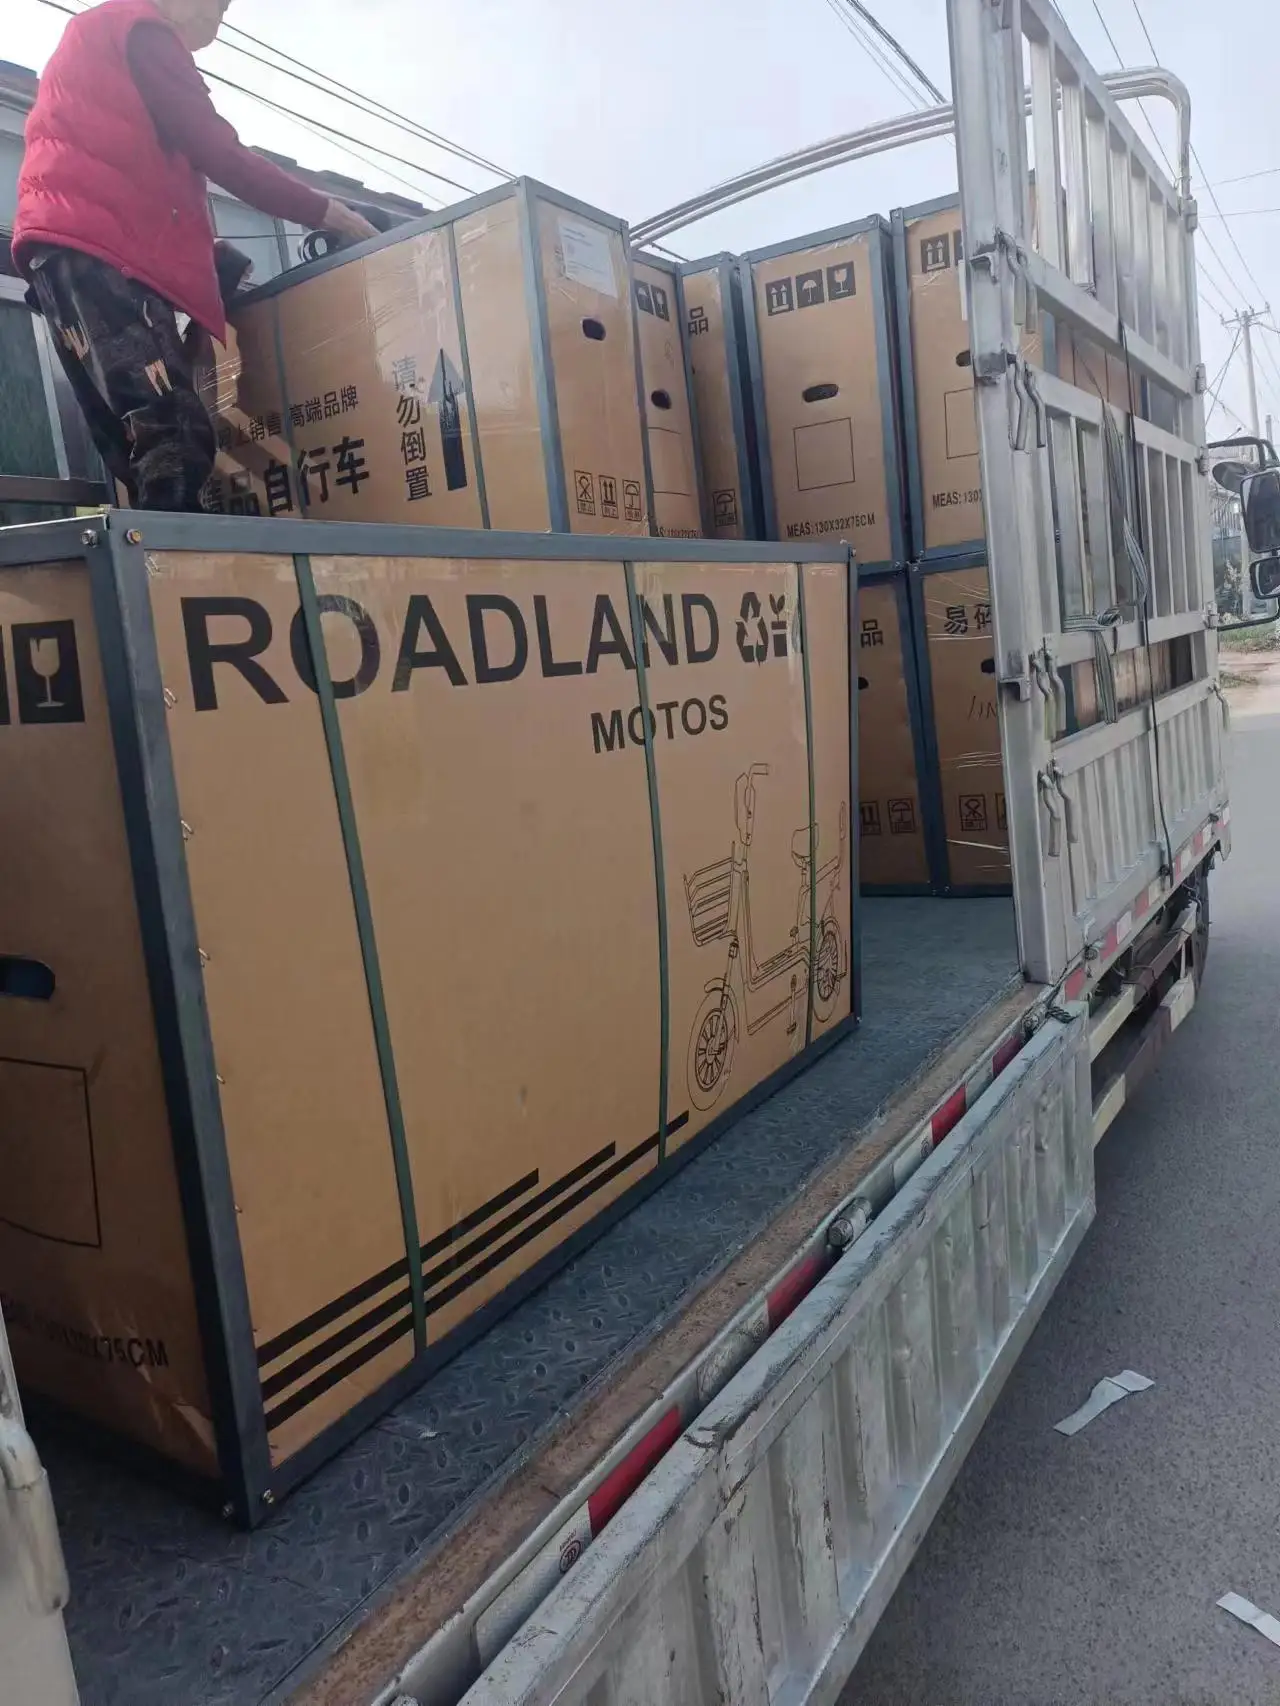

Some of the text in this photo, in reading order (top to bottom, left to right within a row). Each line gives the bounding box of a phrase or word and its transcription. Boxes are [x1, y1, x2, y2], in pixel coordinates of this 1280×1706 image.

[289, 384, 359, 428] 高端品牌
[392, 354, 432, 501] 请勿倒置
[181, 594, 721, 712] ROADLAND
[591, 694, 729, 755] MOTOS
